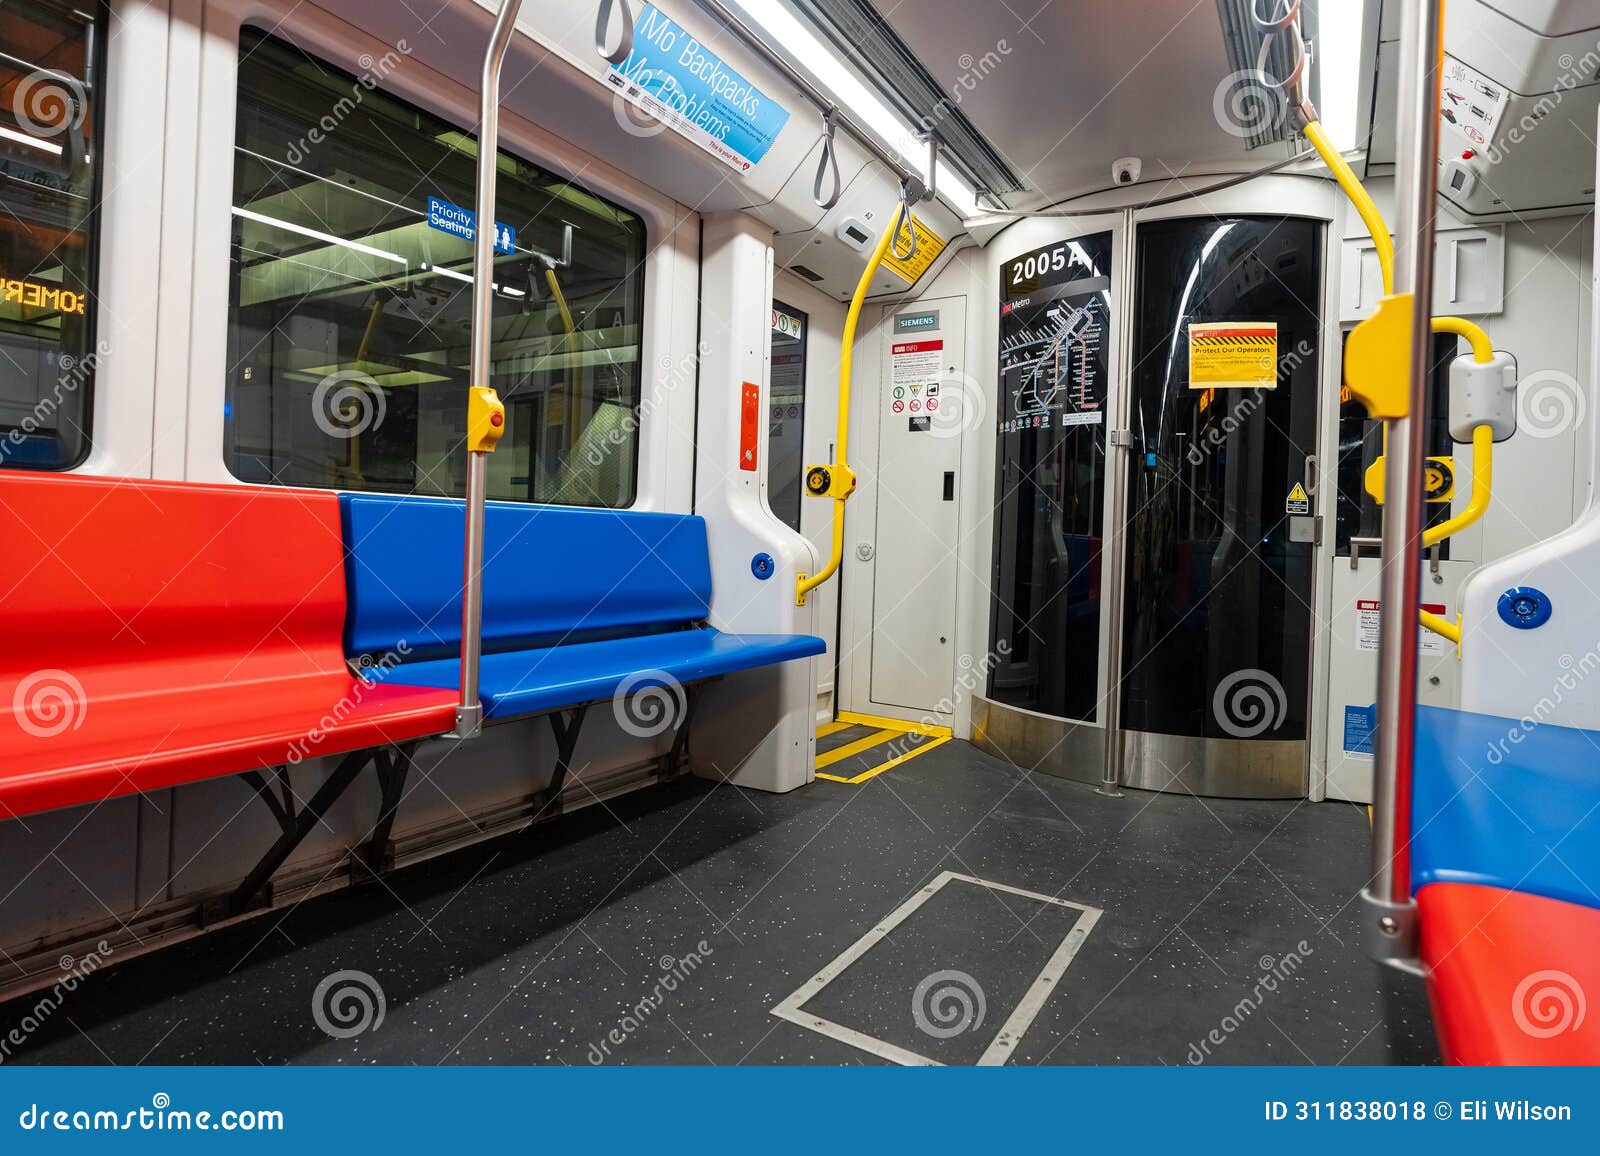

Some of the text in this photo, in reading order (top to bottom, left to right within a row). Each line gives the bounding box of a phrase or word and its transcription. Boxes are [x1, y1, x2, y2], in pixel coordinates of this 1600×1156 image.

[640, 9, 686, 52] Mo'
[678, 38, 759, 121] Backpacks,
[617, 48, 661, 87] Mo'
[655, 75, 731, 141] Problems
[431, 200, 471, 226] Priority
[431, 213, 473, 239] Seating
[1013, 247, 1084, 285] 2005A
[1012, 298, 1030, 310] Metro
[900, 317, 934, 327] SIEMENS
